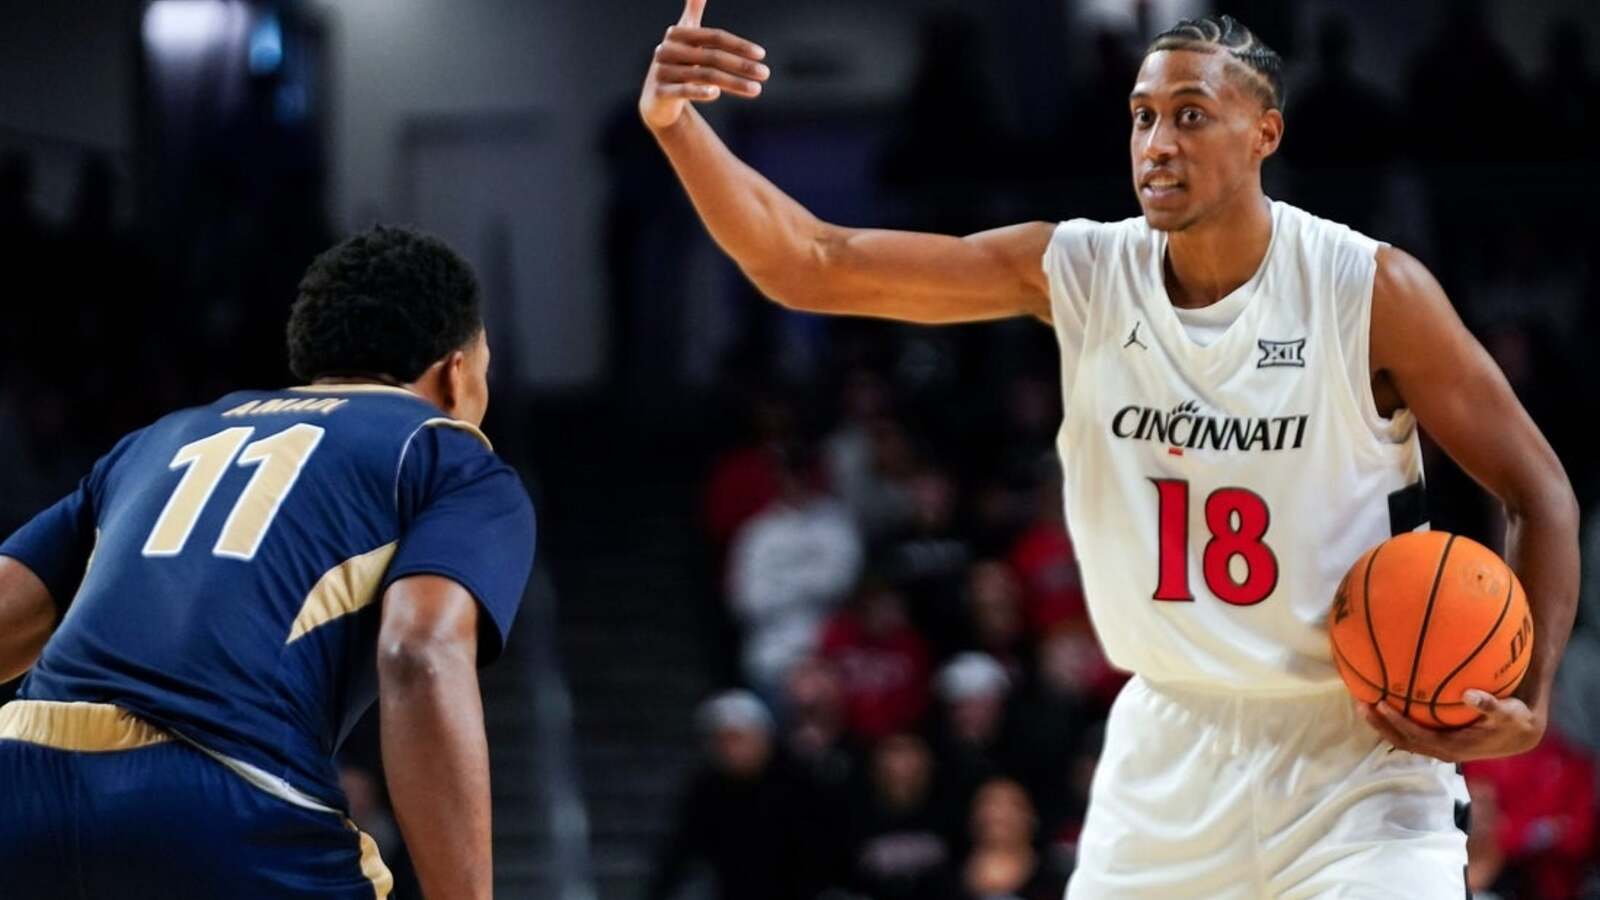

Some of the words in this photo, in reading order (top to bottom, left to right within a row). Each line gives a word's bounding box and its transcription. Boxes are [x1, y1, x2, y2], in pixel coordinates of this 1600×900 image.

[1111, 402, 1309, 451] CINCINNATI
[141, 423, 325, 560] 11
[1146, 477, 1279, 606] 18
